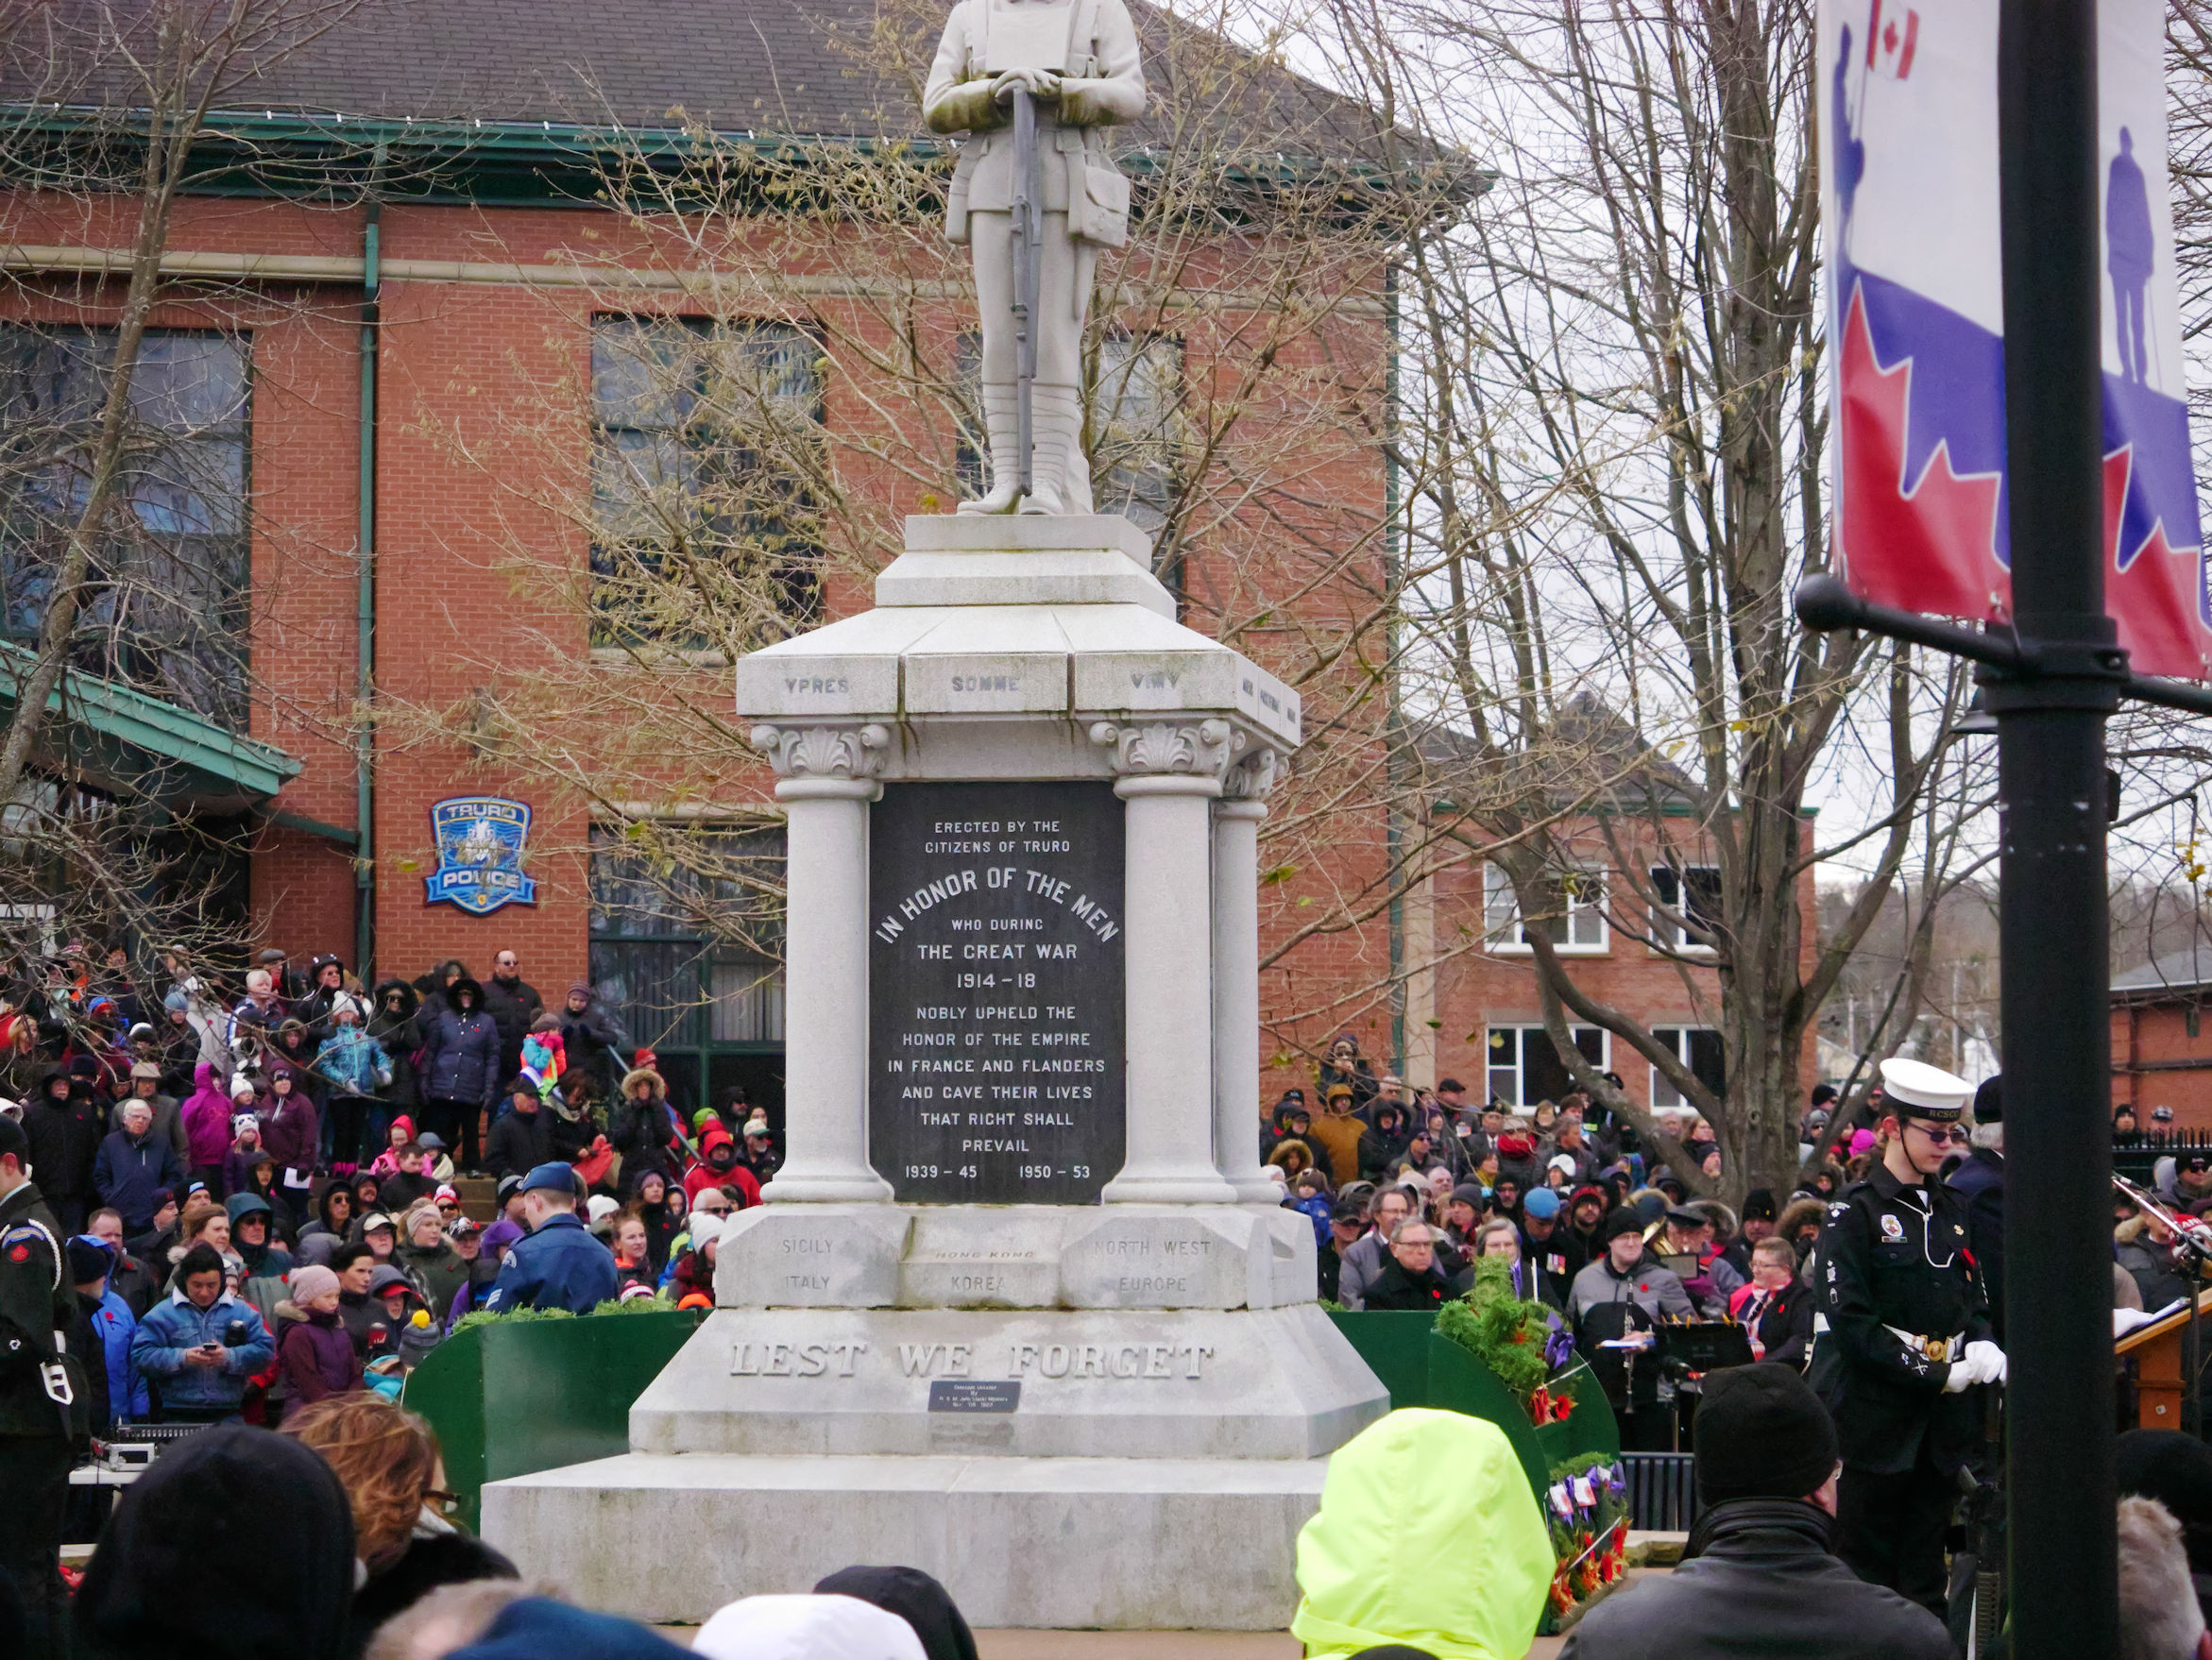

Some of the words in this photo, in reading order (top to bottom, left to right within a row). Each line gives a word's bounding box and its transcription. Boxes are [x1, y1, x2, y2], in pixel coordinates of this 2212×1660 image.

[785, 677, 849, 694] YPRES
[951, 674, 1021, 692] SOMME
[1131, 671, 1181, 690] VIMY
[446, 804, 518, 820] TRURO
[935, 822, 999, 834] ERECTED
[1007, 821, 1027, 833] BY
[1032, 821, 1060, 832] THE
[925, 841, 991, 854] CITIZENS
[998, 840, 1016, 853] OF
[1023, 840, 1070, 853] TRURO
[443, 870, 520, 889] POLICE
[875, 915, 905, 944] IN
[899, 870, 978, 921] HONOR
[987, 867, 1016, 889] OF
[1026, 870, 1071, 905] THE
[1070, 894, 1119, 943] MEN
[951, 919, 982, 931] WHO
[990, 918, 1044, 931] DURING
[917, 944, 953, 960] THE
[963, 943, 1026, 959] GREAT
[1035, 943, 1078, 959] WAR
[916, 1007, 967, 1020] NOBLY
[976, 1006, 1038, 1020] UPHELD
[1046, 1006, 1076, 1020] THE
[903, 1033, 956, 1046] HONOR
[964, 1033, 984, 1046] OF
[992, 1033, 1023, 1046] THE
[1031, 1032, 1090, 1046] EMPIRE
[888, 1059, 903, 1073] IN
[911, 1059, 975, 1073] FRANCE
[981, 1059, 1013, 1073] AND
[1022, 1059, 1105, 1073] FLANDERS
[901, 1086, 933, 1099] AND
[943, 1086, 983, 1099] GAVE
[991, 1086, 1038, 1099] THEIR
[1046, 1086, 1092, 1099] LIVES
[920, 1112, 961, 1126] THAT
[968, 1112, 1016, 1126] RIGHT
[1024, 1112, 1074, 1126] SHALL
[962, 1139, 1029, 1152] PREVAIL
[782, 1239, 832, 1254] SICILY
[1094, 1240, 1149, 1255] NORTH
[1163, 1240, 1211, 1255] WEST
[785, 1276, 830, 1290] ITALY
[951, 1276, 1006, 1291] KOREA
[1118, 1277, 1187, 1292] EUROPE
[729, 1343, 866, 1378] LEST
[897, 1342, 972, 1378] WE
[1008, 1342, 1215, 1380] FORGET
